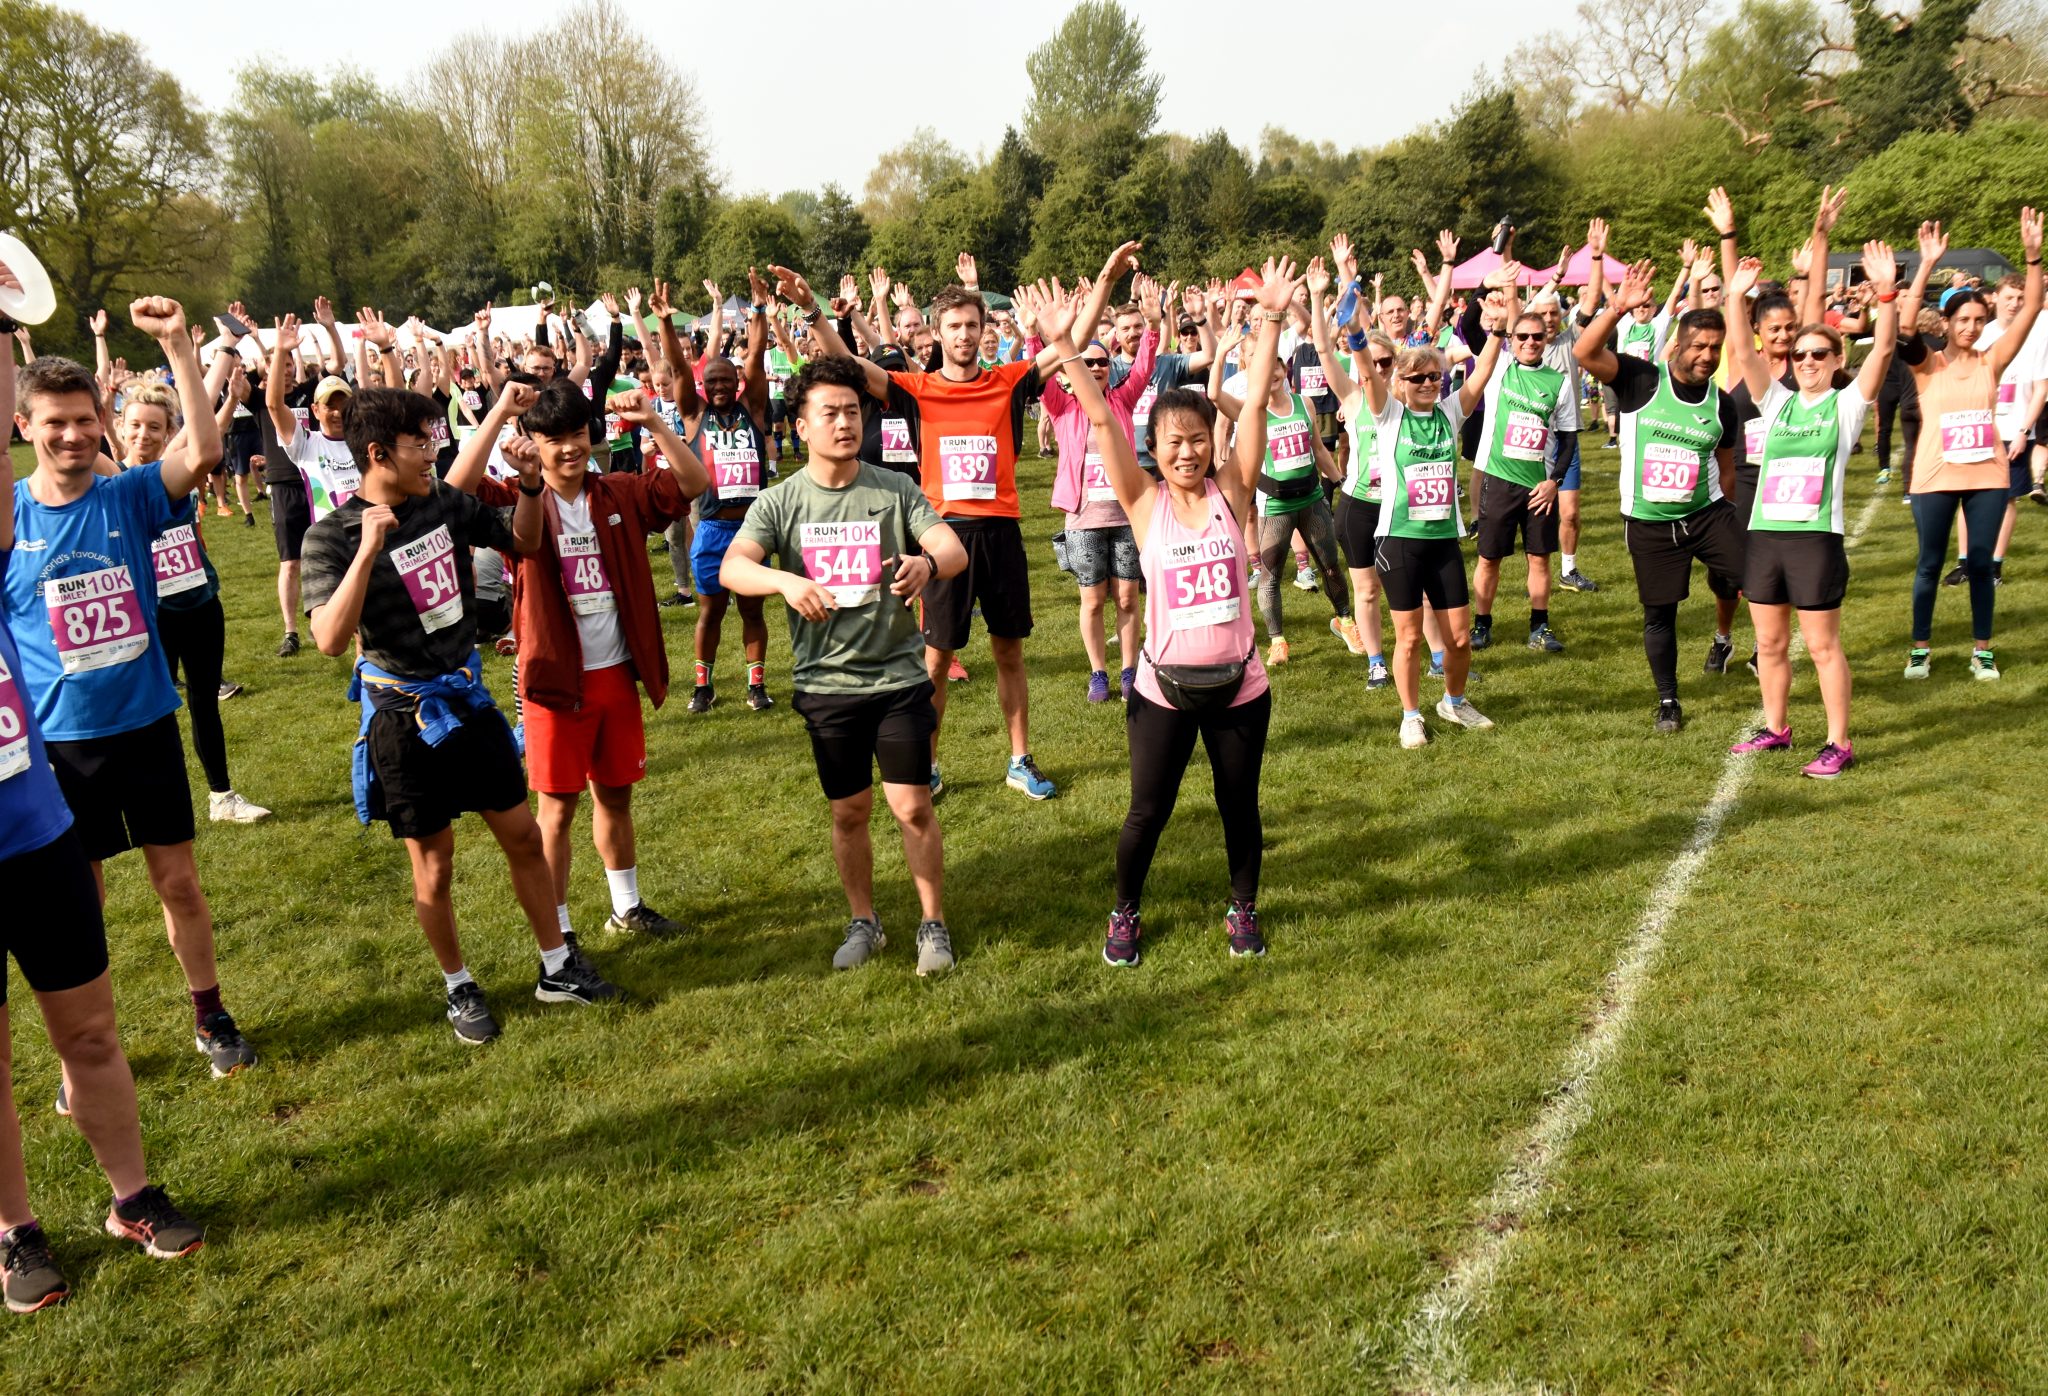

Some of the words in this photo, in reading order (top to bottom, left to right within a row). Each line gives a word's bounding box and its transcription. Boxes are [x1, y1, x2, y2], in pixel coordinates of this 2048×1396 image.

[1305, 376, 1324, 388] 267
[1288, 422, 1308, 433] 10K
[1968, 412, 1990, 422] 10K
[889, 430, 912, 449] 79
[1510, 426, 1543, 449] 829
[1640, 417, 1682, 432] Windle
[1685, 426, 1718, 442] Valley
[1652, 429, 1704, 448] Runners
[1949, 425, 1984, 449] 281
[737, 450, 758, 460] 10K
[969, 438, 996, 452] 10K
[1277, 435, 1305, 457] 411
[1654, 446, 1671, 454] RUN
[1673, 448, 1698, 462] 10K
[722, 463, 752, 485] 791
[948, 454, 990, 482] 839
[1430, 464, 1453, 476] 10K
[1648, 461, 1690, 488] 350
[1414, 479, 1449, 505] 359
[1775, 476, 1807, 503] 82
[168, 527, 193, 544] 10K
[405, 541, 428, 559] RUN
[428, 526, 453, 554] 10K
[570, 536, 589, 546] RUN
[805, 536, 838, 544] FRIMLEY
[814, 526, 838, 536] RUN
[840, 524, 878, 542] 10K
[563, 545, 590, 554] FRIMLEY
[1172, 545, 1196, 557] RUN
[1197, 537, 1234, 559] 10K
[157, 545, 196, 576] 431
[400, 551, 431, 571] FRIMLEY
[814, 548, 871, 585] 544
[1166, 556, 1196, 565] RIMLEY
[35, 581, 45, 597] the
[41, 553, 70, 578] world's
[71, 550, 115, 568] favourite
[58, 579, 87, 594] RUN
[87, 569, 132, 595] 10K
[417, 552, 460, 606] 547
[574, 556, 611, 591] 48
[1176, 562, 1232, 606] 548
[64, 597, 131, 646] 825
